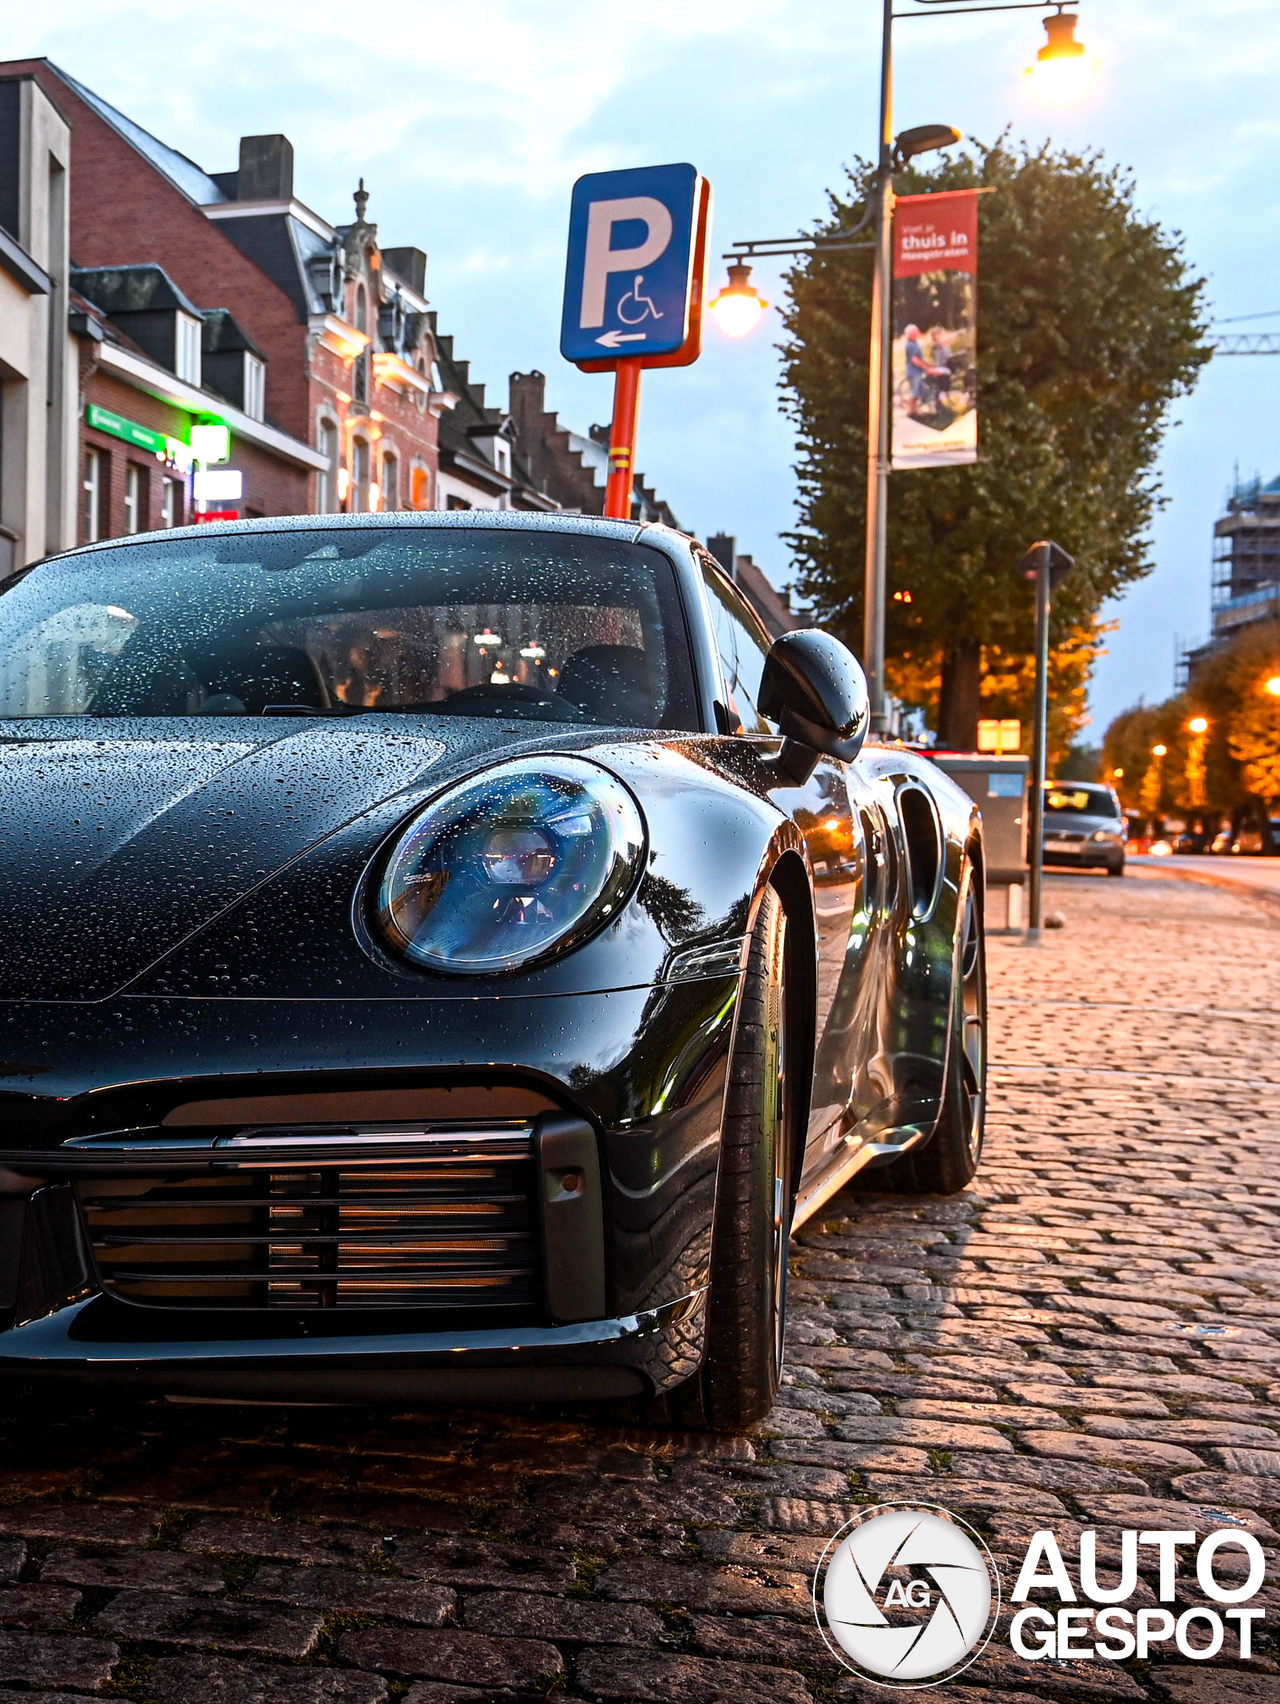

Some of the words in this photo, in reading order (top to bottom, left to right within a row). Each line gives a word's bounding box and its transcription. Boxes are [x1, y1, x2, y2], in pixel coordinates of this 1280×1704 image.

[579, 196, 673, 329] P
[902, 232, 946, 250] thuis
[951, 229, 968, 245] in
